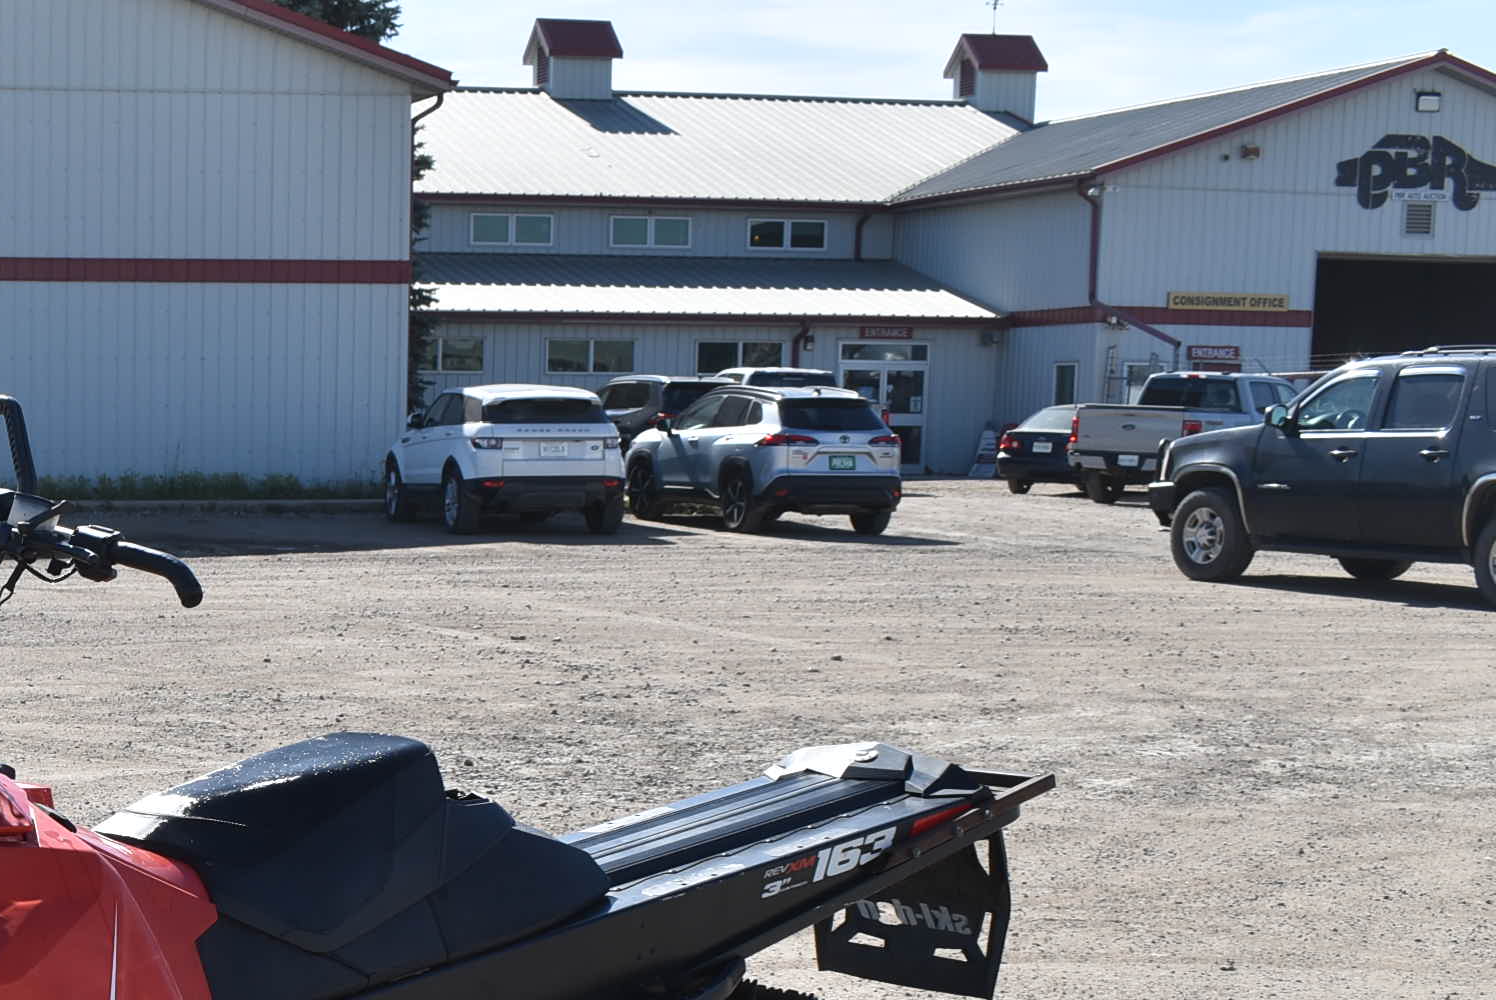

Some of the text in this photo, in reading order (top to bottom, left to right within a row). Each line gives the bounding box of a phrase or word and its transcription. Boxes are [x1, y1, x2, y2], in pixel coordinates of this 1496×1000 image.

[1172, 295, 1285, 308] CONSIGNMENT OFFICE
[1191, 347, 1236, 359] ENTRANCE
[812, 826, 897, 883] 163
